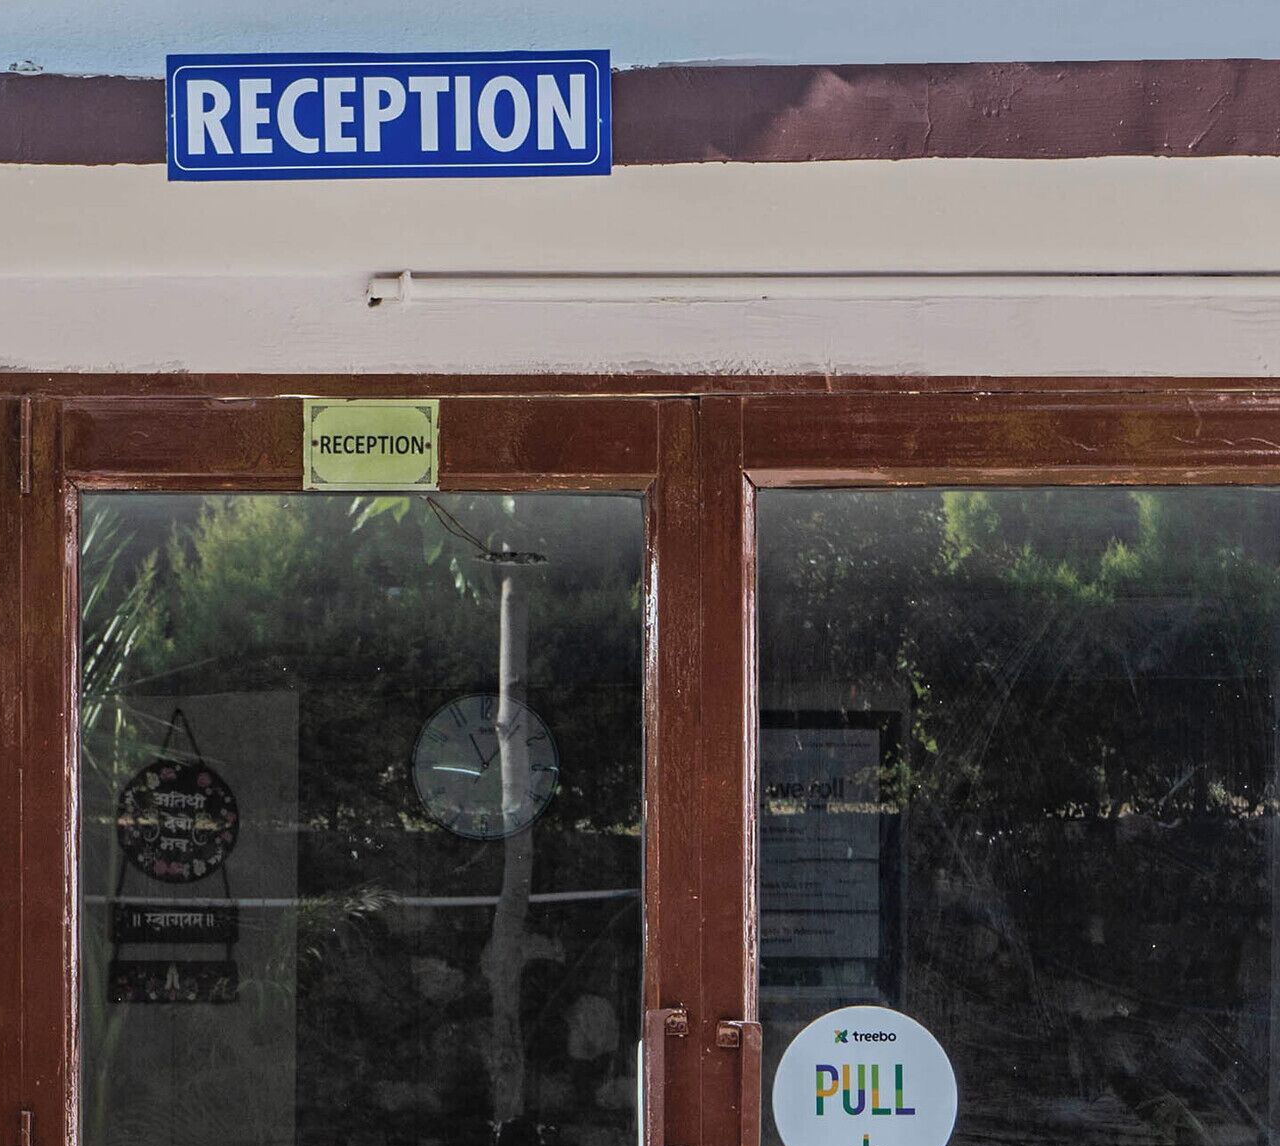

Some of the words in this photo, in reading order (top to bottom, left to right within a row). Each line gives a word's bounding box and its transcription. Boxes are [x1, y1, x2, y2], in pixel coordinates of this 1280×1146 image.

[186, 73, 587, 155] RECEPTION
[320, 434, 425, 455] RECEPTION
[852, 1031, 897, 1042] treebo
[816, 1064, 916, 1116] PULL
